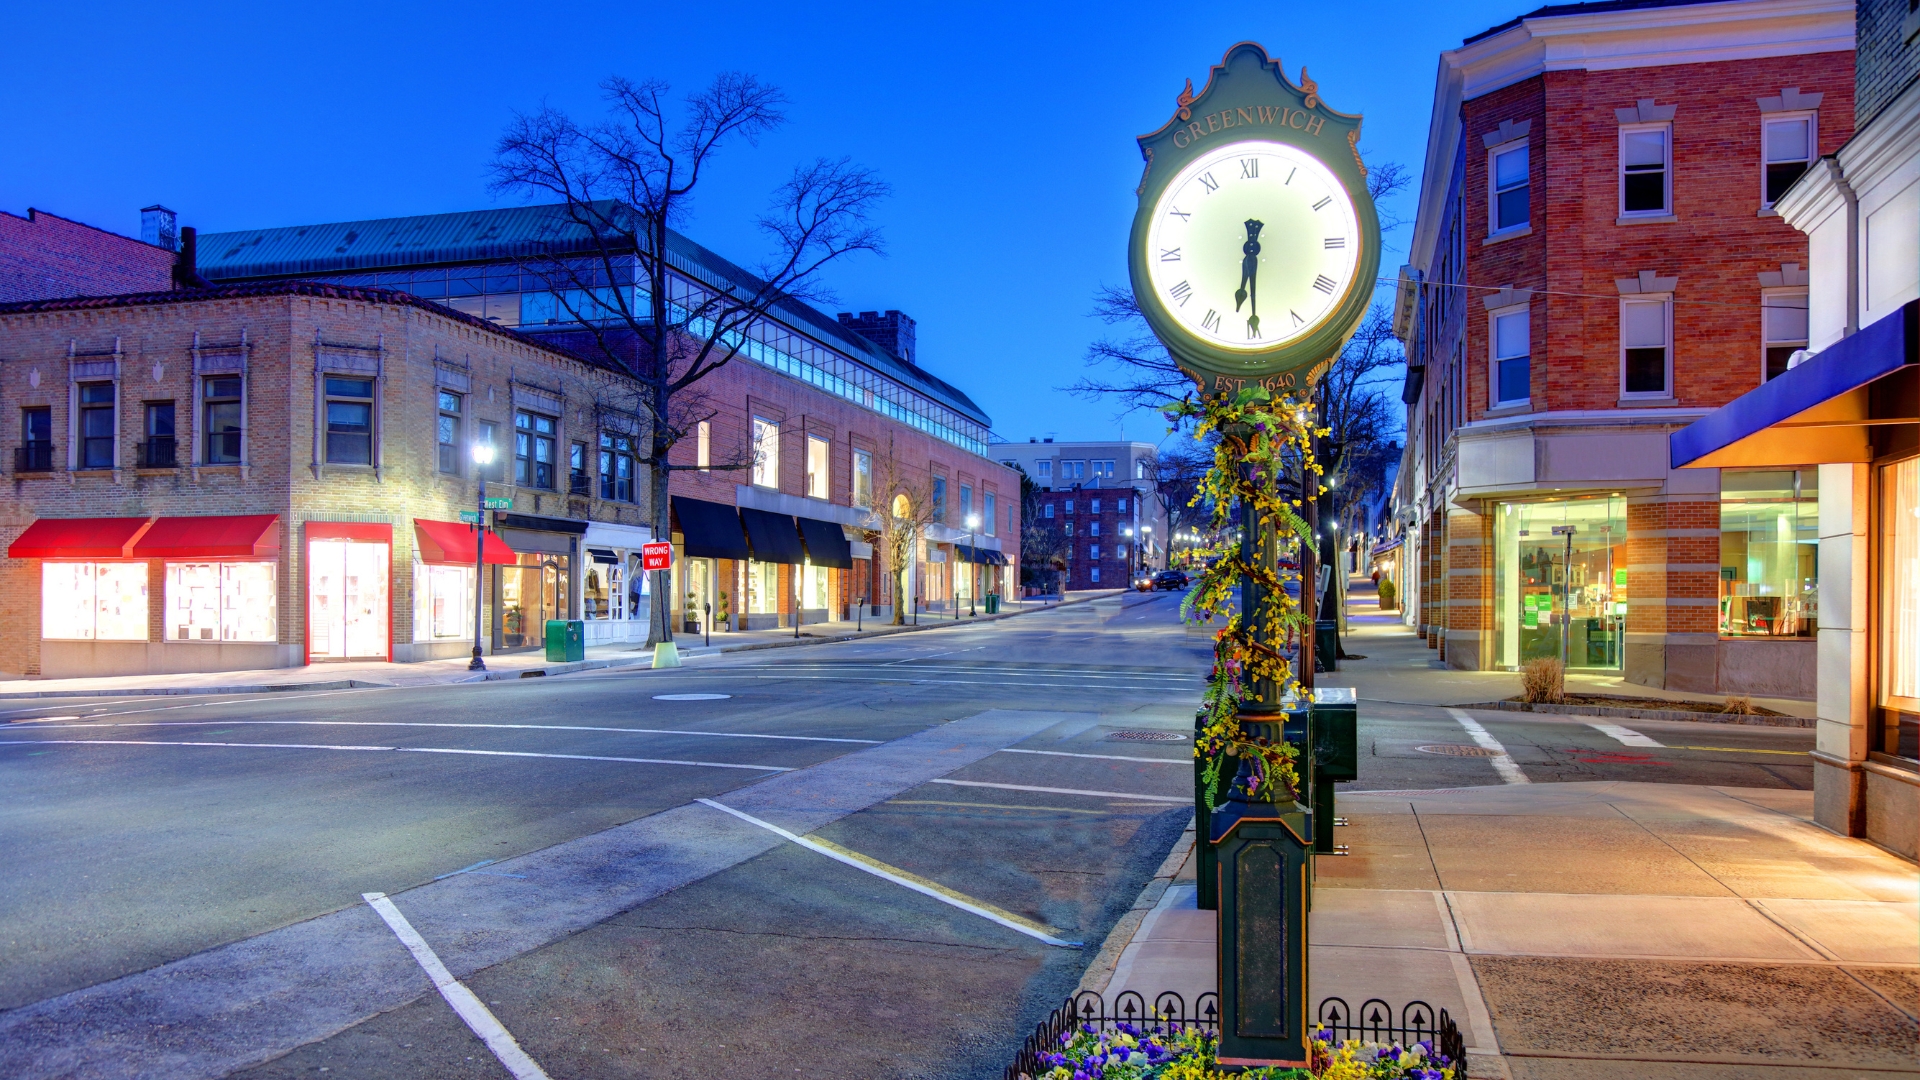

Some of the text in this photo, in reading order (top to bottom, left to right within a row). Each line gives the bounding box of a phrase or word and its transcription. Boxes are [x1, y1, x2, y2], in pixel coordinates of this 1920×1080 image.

[1173, 105, 1327, 149] GREENWICH
[1240, 158, 1259, 179] XII
[1284, 167, 1297, 186] I
[1198, 171, 1220, 195] XI
[1312, 195, 1333, 212] II
[1169, 205, 1192, 223] X
[1324, 237, 1345, 250] III
[1160, 247, 1181, 262] IX
[1169, 279, 1194, 308] VIII
[1201, 308, 1222, 334] VII
[1289, 308, 1305, 328] V
[1258, 372, 1296, 392] 1640
[484, 500, 498, 509] West
[499, 499, 508, 508] Elm
[644, 546, 668, 556] WRONG
[648, 558, 663, 566] WAY
